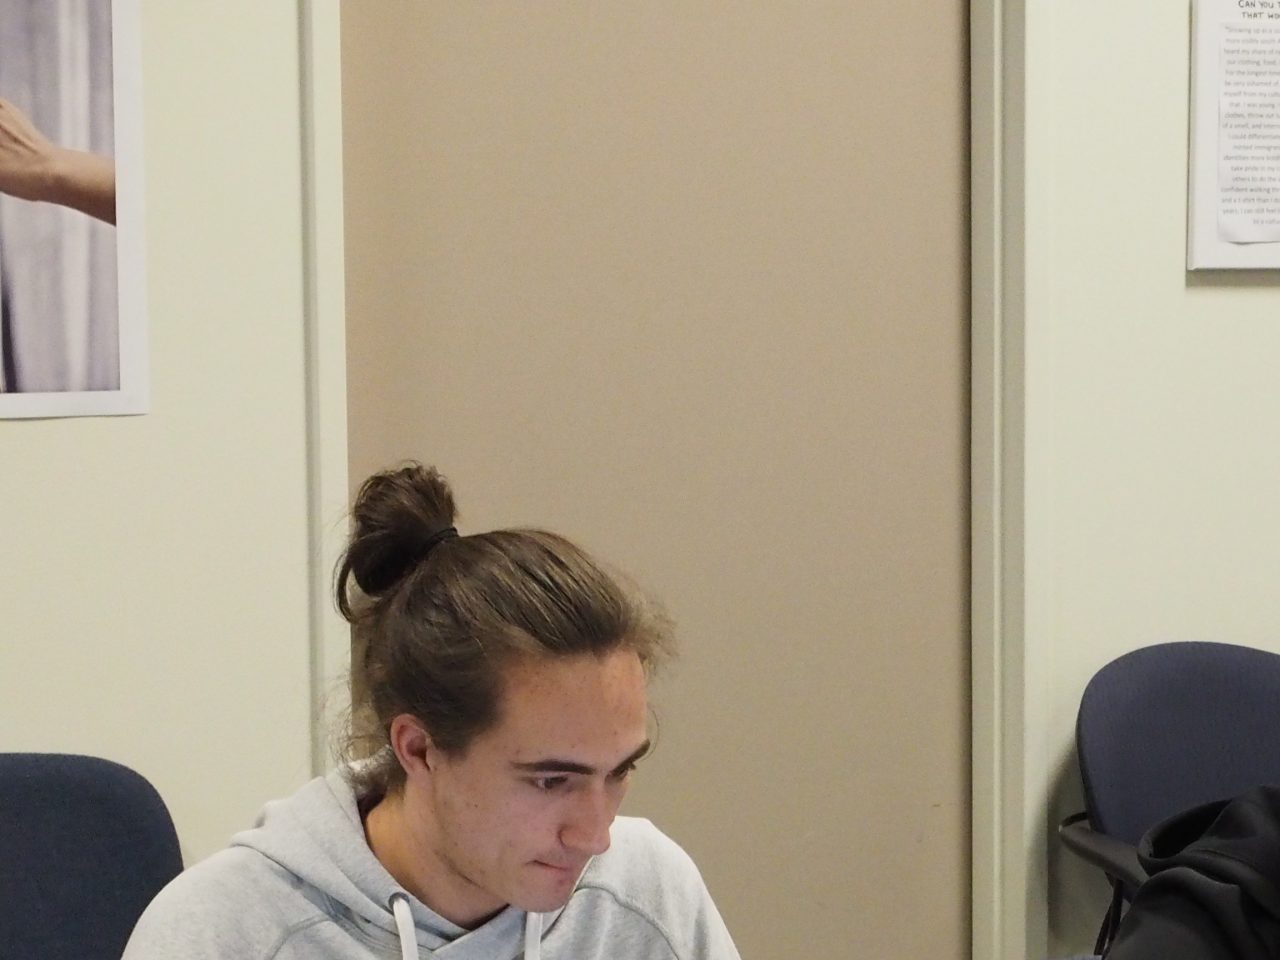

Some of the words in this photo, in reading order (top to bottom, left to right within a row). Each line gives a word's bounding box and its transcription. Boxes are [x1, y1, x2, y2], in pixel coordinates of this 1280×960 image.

[1238, 0, 1256, 8] CAN
[1259, 1, 1274, 9] YOU
[1241, 11, 1264, 19] THAT
